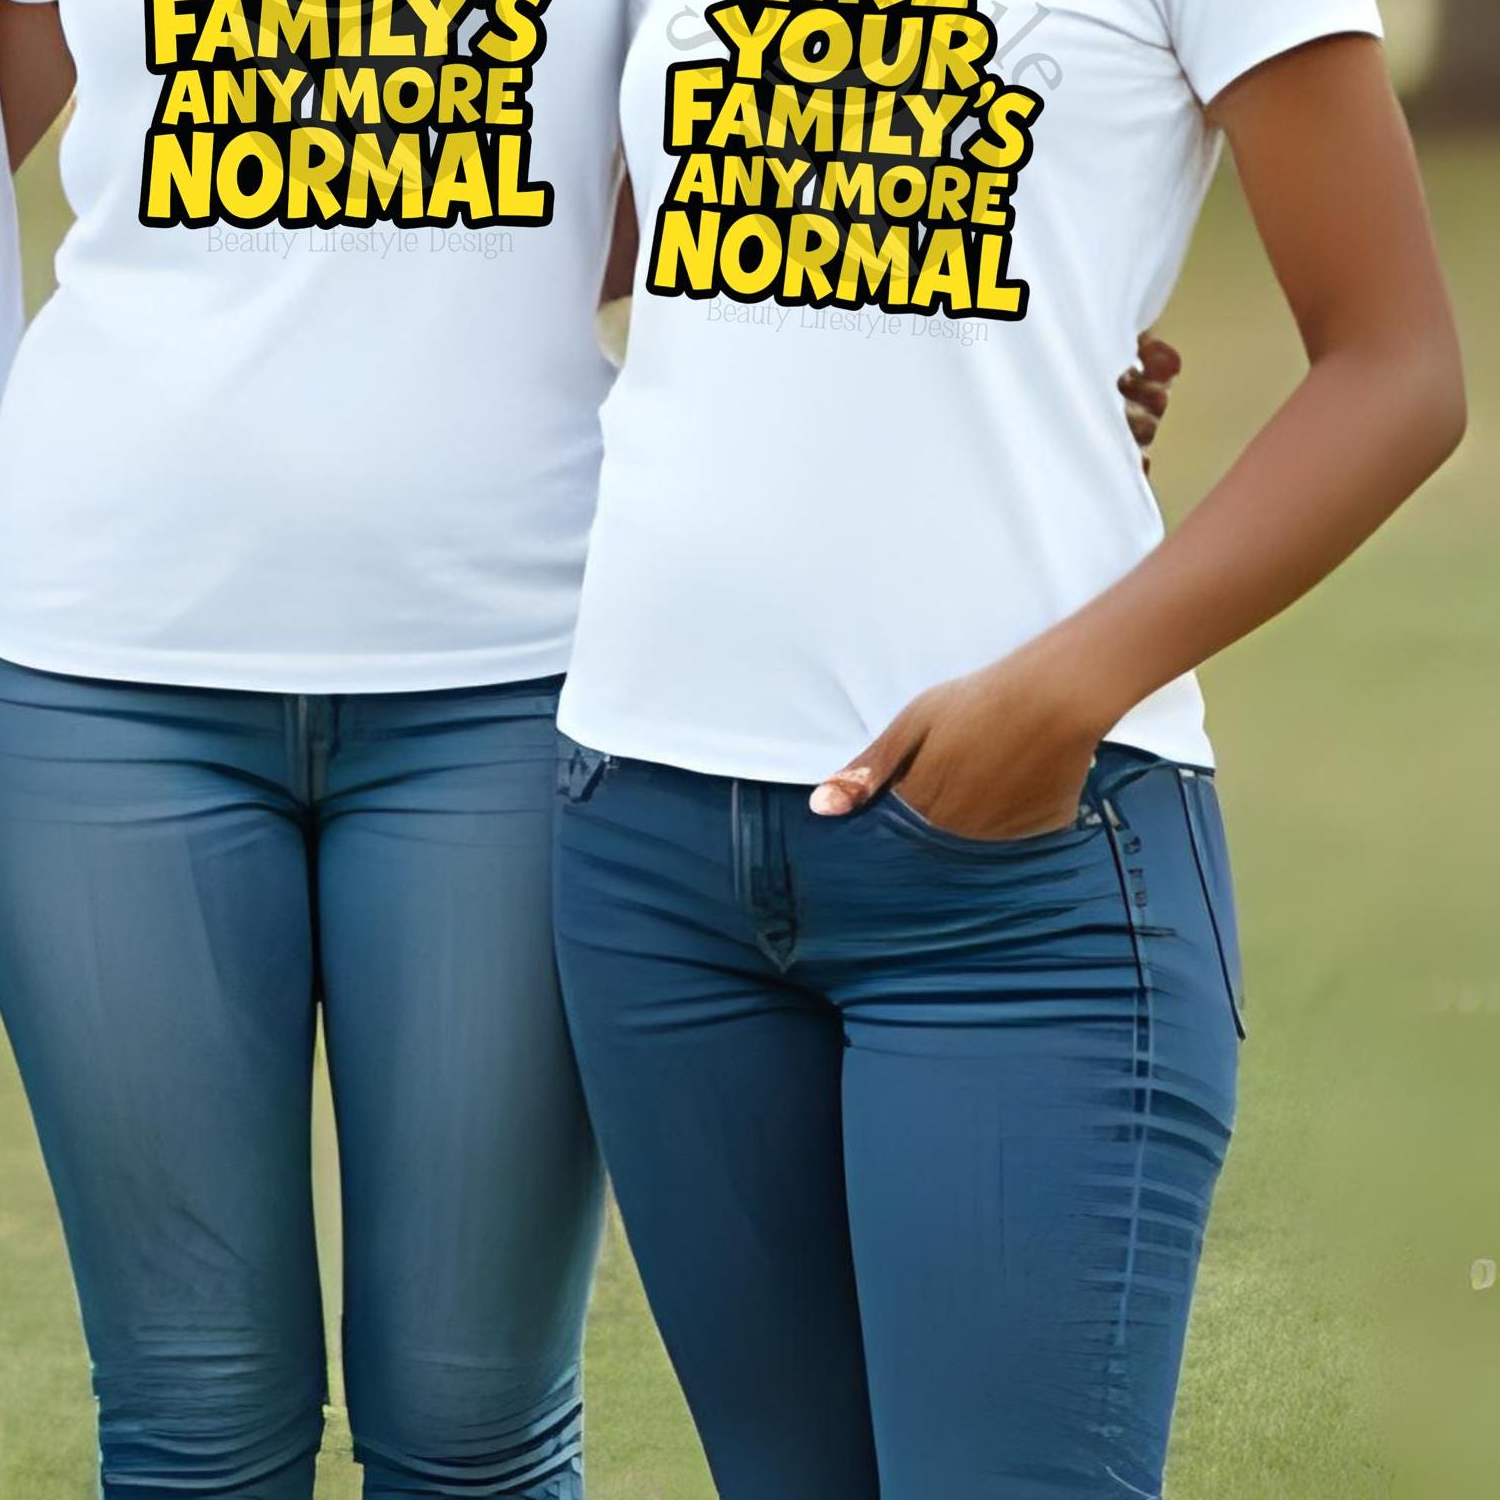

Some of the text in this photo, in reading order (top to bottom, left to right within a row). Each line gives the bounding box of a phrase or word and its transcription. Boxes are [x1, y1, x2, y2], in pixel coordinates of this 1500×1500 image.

[158, 60, 526, 128] ANY MORE
[710, 2, 992, 93] YOUR
[668, 63, 1038, 171] FAMILY'S
[144, 123, 548, 223] NORMAL
[670, 150, 1012, 229] ANY MORE
[651, 207, 1024, 315] NORMAL
